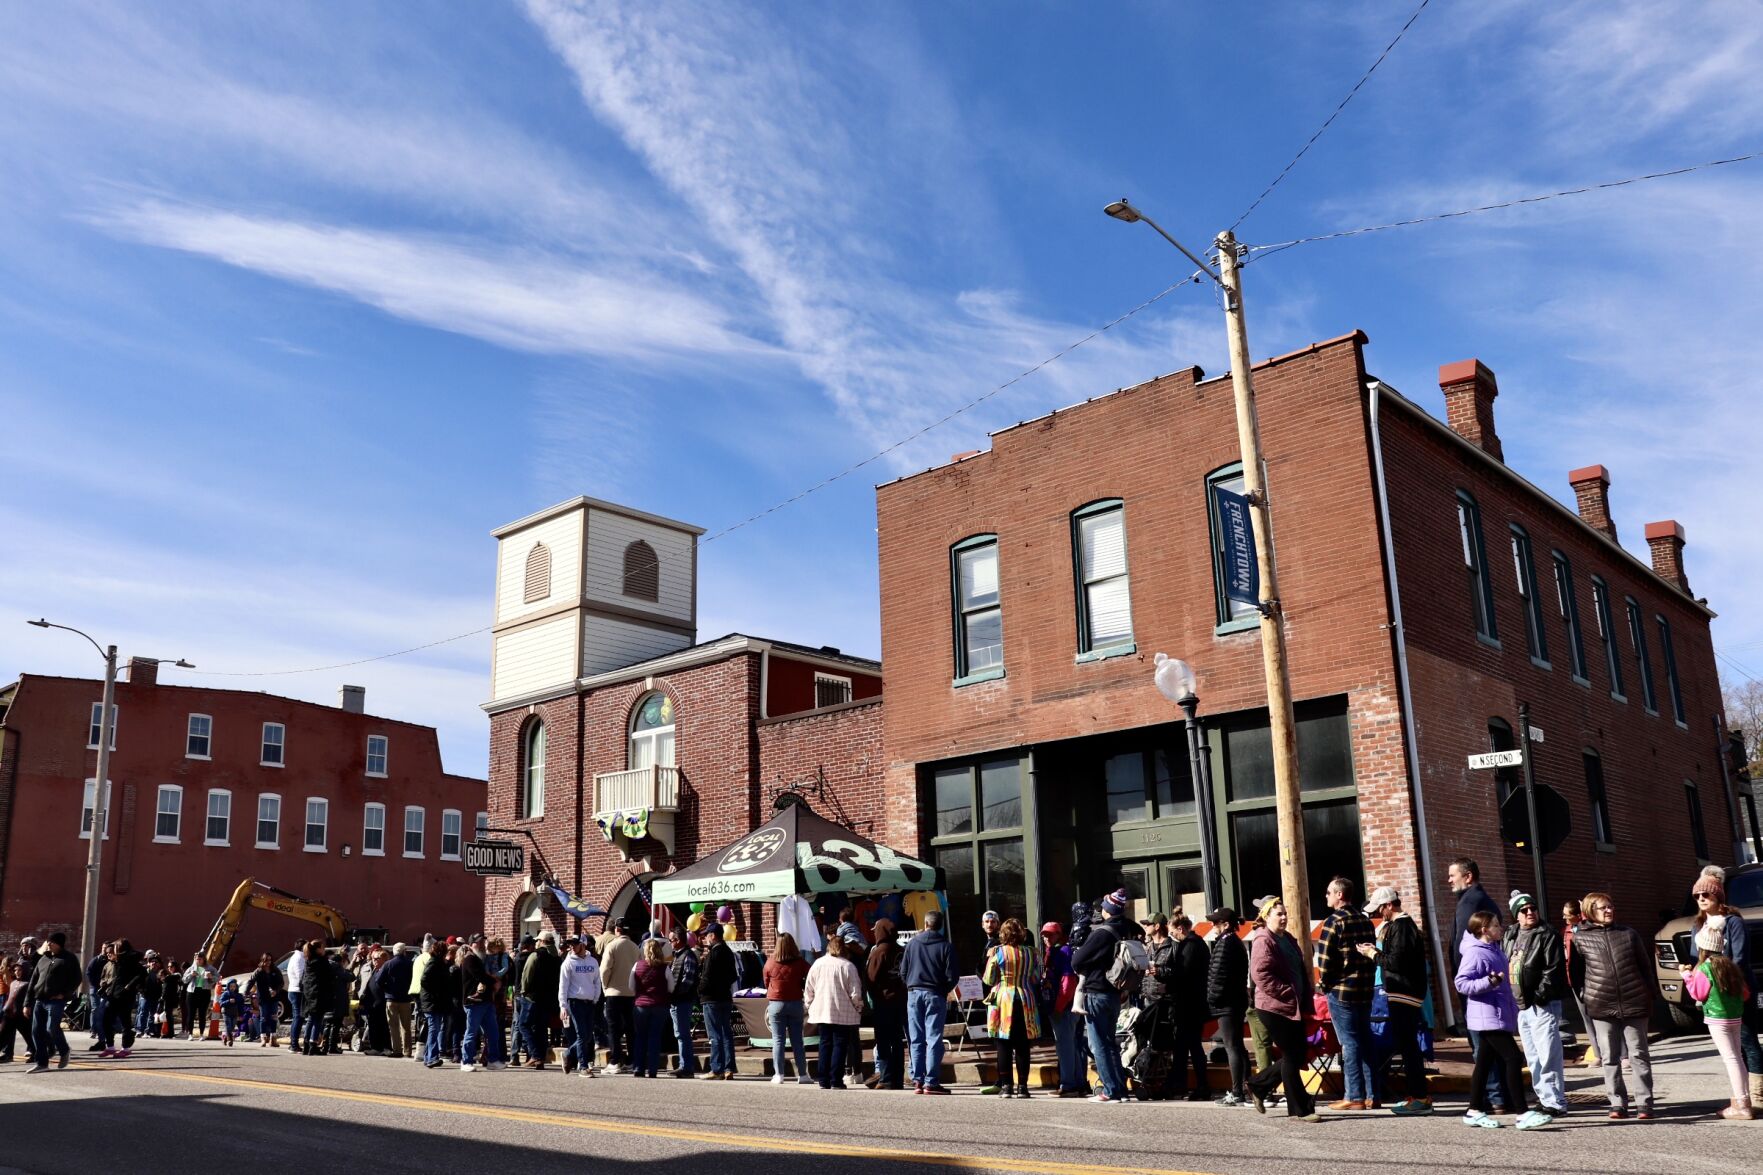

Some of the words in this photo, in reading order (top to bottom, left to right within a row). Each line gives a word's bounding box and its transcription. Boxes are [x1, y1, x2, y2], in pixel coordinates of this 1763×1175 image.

[1229, 501, 1250, 591] FRENCHTOWN
[1485, 753, 1513, 766] SECOND
[747, 833, 781, 844] LOCAL
[467, 846, 494, 867] GOOD
[495, 848, 522, 869] NEWS
[796, 839, 937, 892] 636
[687, 881, 755, 897] local636.com
[274, 903, 294, 913] ideal
